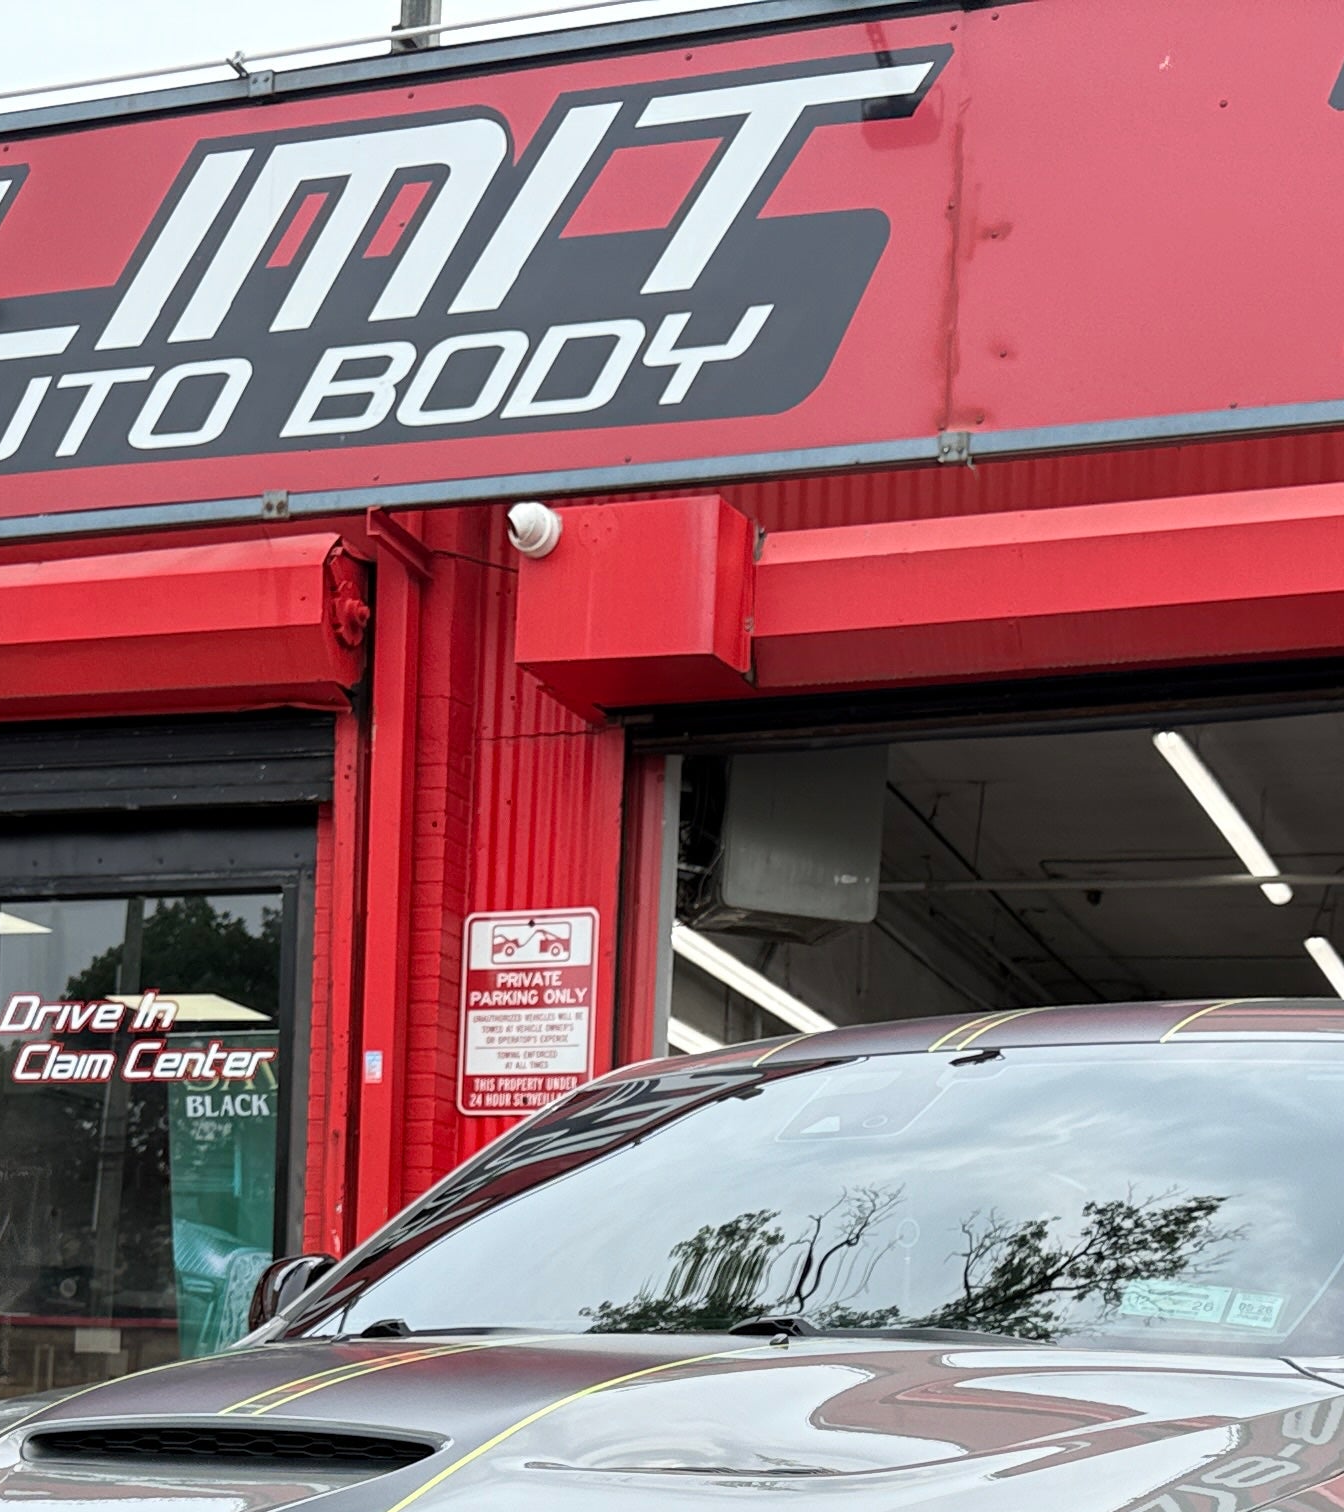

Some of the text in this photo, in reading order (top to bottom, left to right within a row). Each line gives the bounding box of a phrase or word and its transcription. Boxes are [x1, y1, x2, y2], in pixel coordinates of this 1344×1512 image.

[278, 302, 775, 440] BODY
[495, 970, 563, 989] PRIVATE
[469, 987, 588, 1007] PARKING ONLY
[130, 990, 178, 1032] In
[524, 1012, 555, 1022] VEHICLES
[558, 1012, 572, 1021] WILL
[575, 1011, 584, 1021] BE
[481, 1025, 504, 1034] TOWED
[505, 1024, 514, 1033] AT
[516, 1024, 543, 1033] VEHICLE
[540, 1034, 569, 1043] EXPENSE
[13, 1041, 116, 1082] Claim
[122, 1040, 277, 1081] Center
[496, 1049, 558, 1060] TOWING ENFORCED
[504, 1060, 549, 1070] AT ALL TIMES
[473, 1076, 578, 1092] THIS PROPERTY UNDER
[185, 1093, 271, 1118] BLACK
[469, 1093, 483, 1108] 24
[485, 1092, 512, 1107] HOUR
